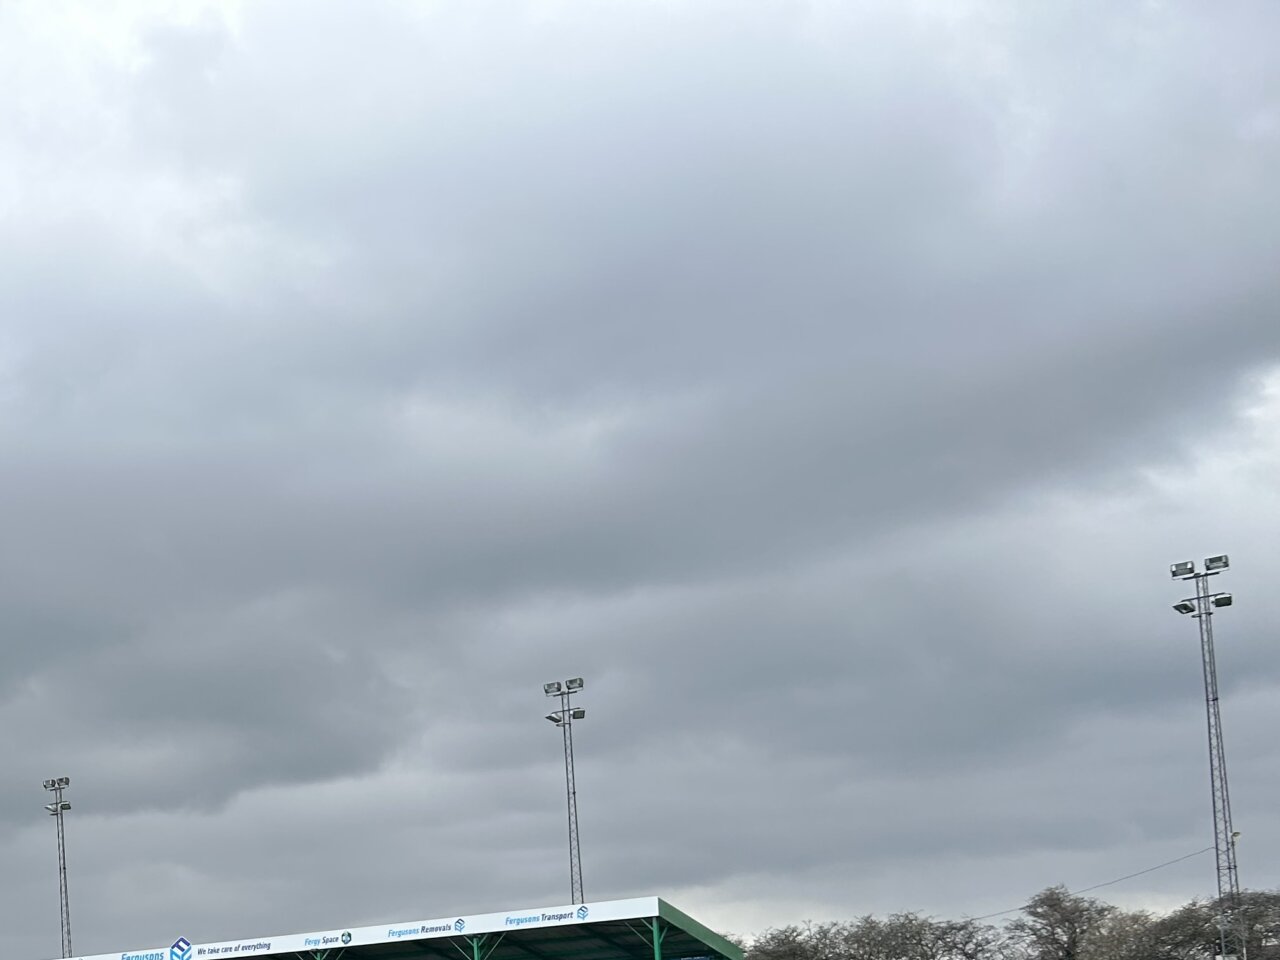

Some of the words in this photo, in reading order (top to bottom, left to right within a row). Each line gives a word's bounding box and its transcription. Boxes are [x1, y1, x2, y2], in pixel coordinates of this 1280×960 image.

[505, 915, 540, 926] Fergusons
[541, 912, 574, 922] Transport
[388, 928, 420, 938] Fergusons
[421, 924, 452, 934] Removals
[305, 937, 320, 946] Fergy
[322, 935, 339, 944] Space
[241, 942, 272, 952] everything
